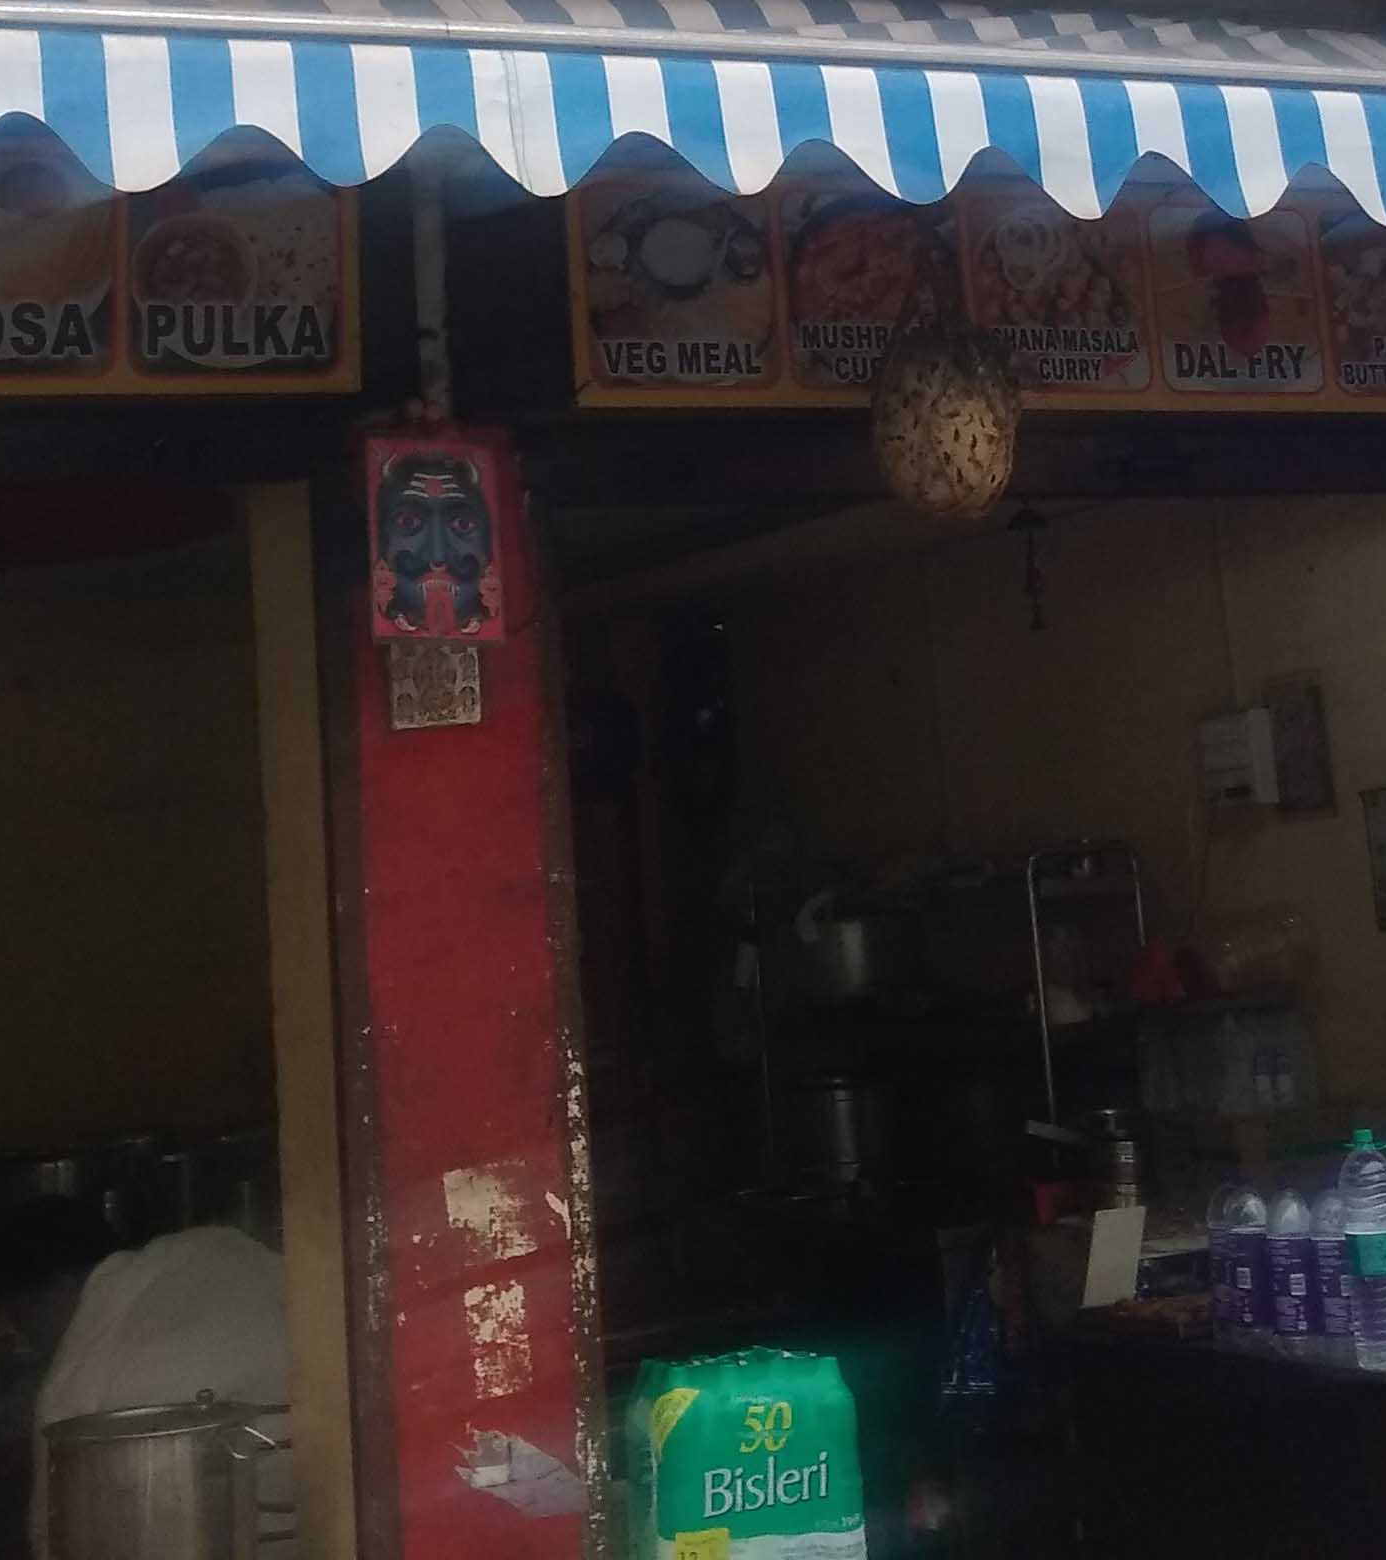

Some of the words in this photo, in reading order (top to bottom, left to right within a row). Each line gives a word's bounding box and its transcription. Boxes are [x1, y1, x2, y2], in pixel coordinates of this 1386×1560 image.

[145, 303, 327, 358] PULKA
[1062, 328, 1140, 353] MASALA
[603, 342, 667, 375] VEG
[677, 342, 761, 375] MEAL
[1038, 357, 1101, 381] CURRY
[1173, 343, 1237, 378] DAL
[1248, 343, 1306, 379] FRY
[739, 1401, 793, 1453] 50
[703, 1451, 830, 1518] Bisleri
